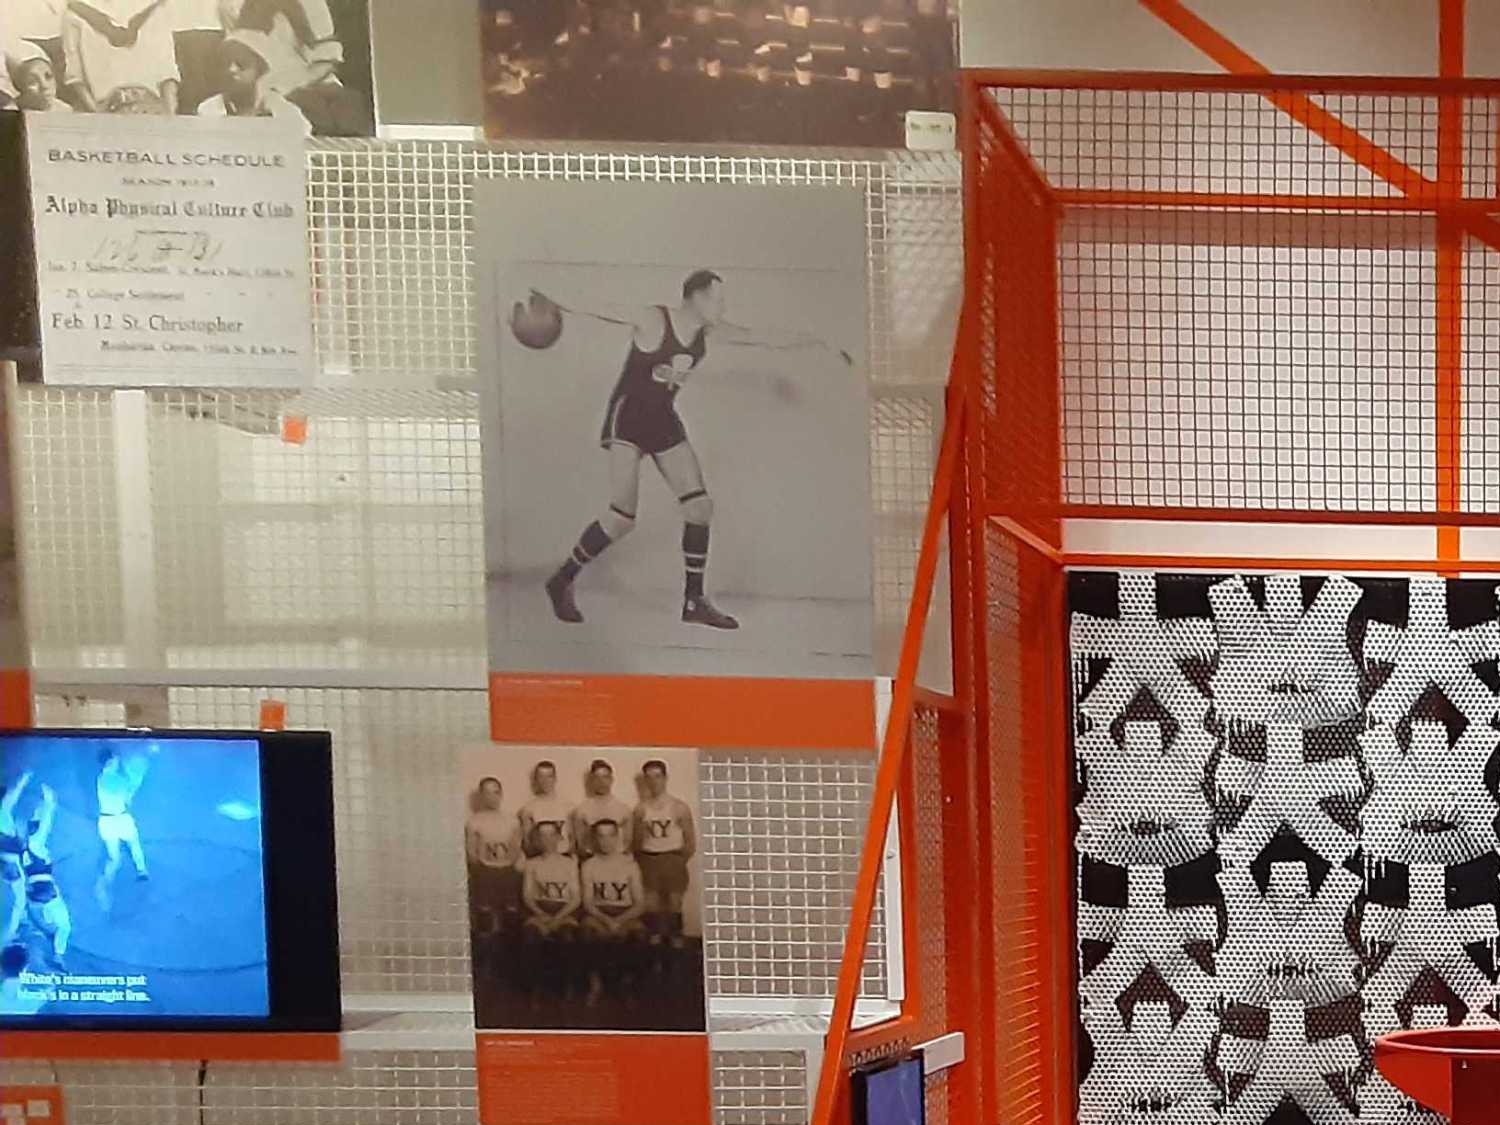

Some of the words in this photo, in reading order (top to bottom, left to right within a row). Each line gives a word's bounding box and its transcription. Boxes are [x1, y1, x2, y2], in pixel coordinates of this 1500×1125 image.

[48, 149, 177, 166] BASKETBALL
[182, 152, 287, 168] SCHEDULE
[45, 194, 99, 217] Alpha
[149, 313, 244, 334] Christopher
